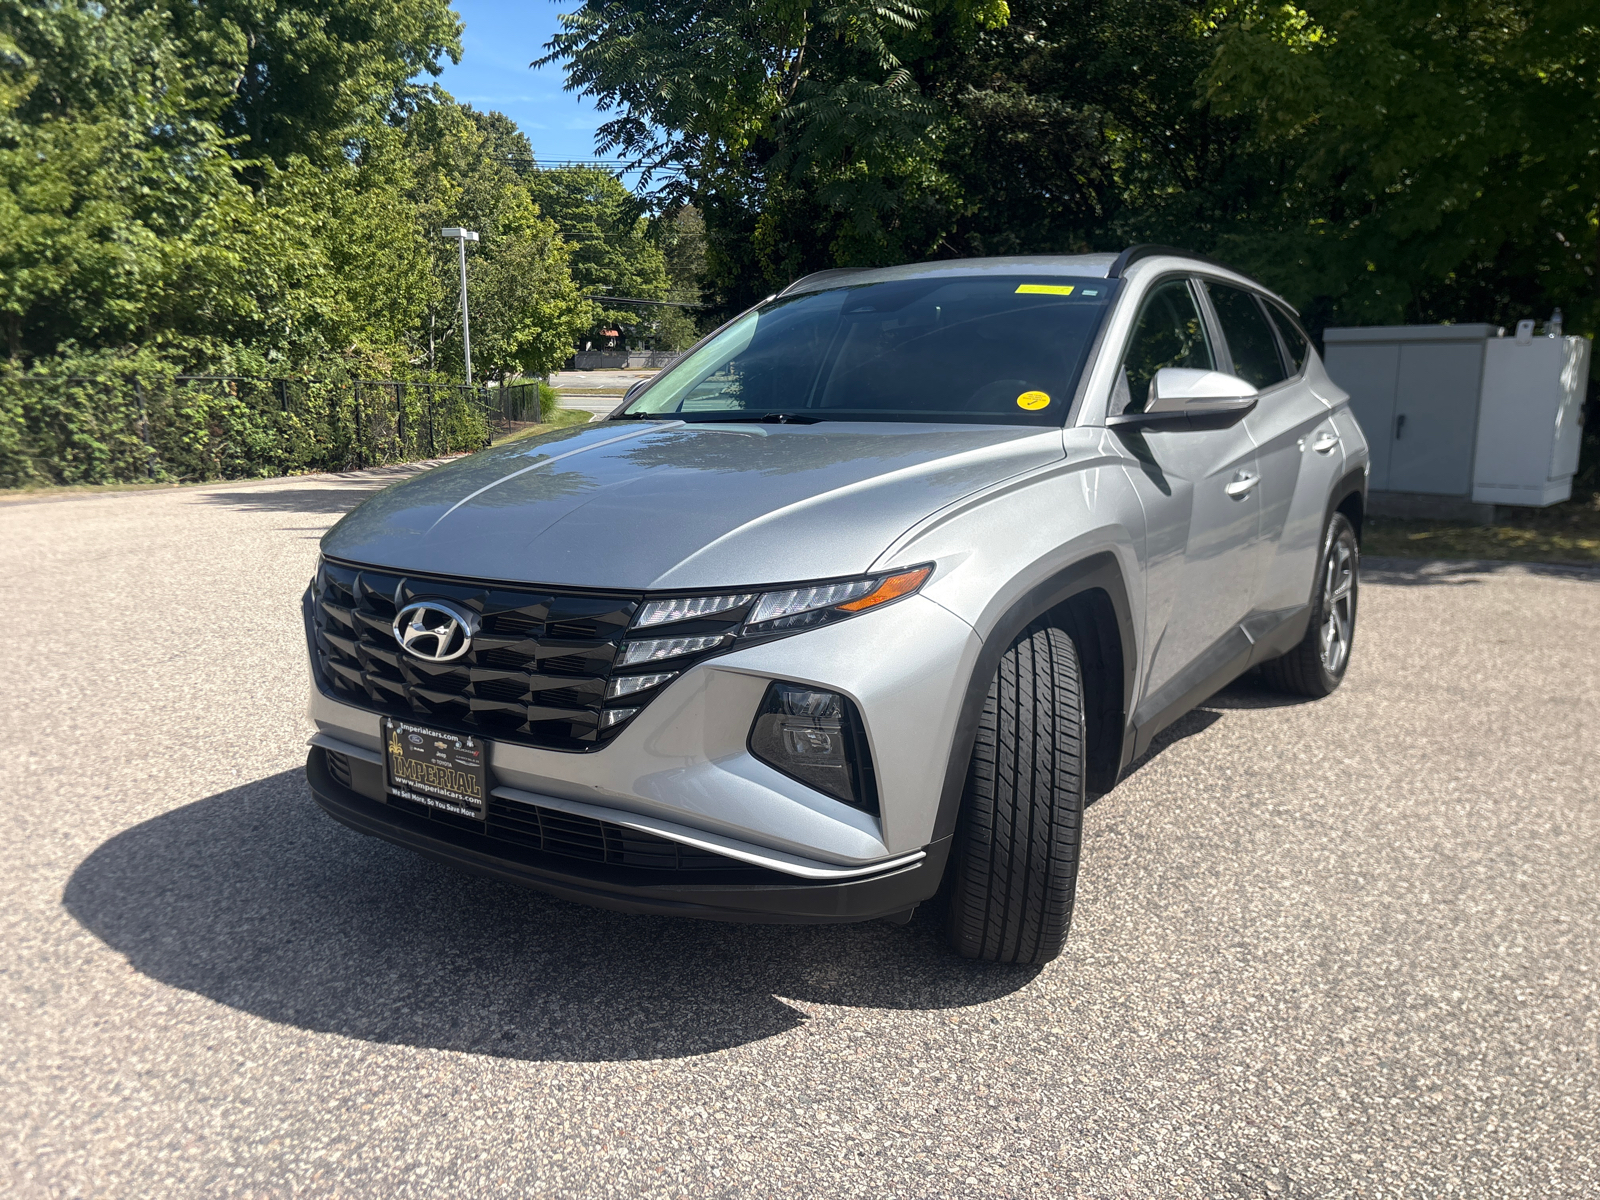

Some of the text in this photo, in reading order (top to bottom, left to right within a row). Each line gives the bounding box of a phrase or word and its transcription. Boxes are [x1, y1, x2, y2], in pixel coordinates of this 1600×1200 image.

[400, 722, 459, 742] Imperialcars.com
[393, 755, 481, 797] IMPERIAL
[395, 776, 482, 805] www.imperialcars.com
[391, 788, 401, 796] We
[401, 790, 411, 799] Sell
[427, 798, 435, 806] So
[435, 800, 446, 809] You
[446, 804, 460, 814] Save
[461, 807, 476, 818] More
